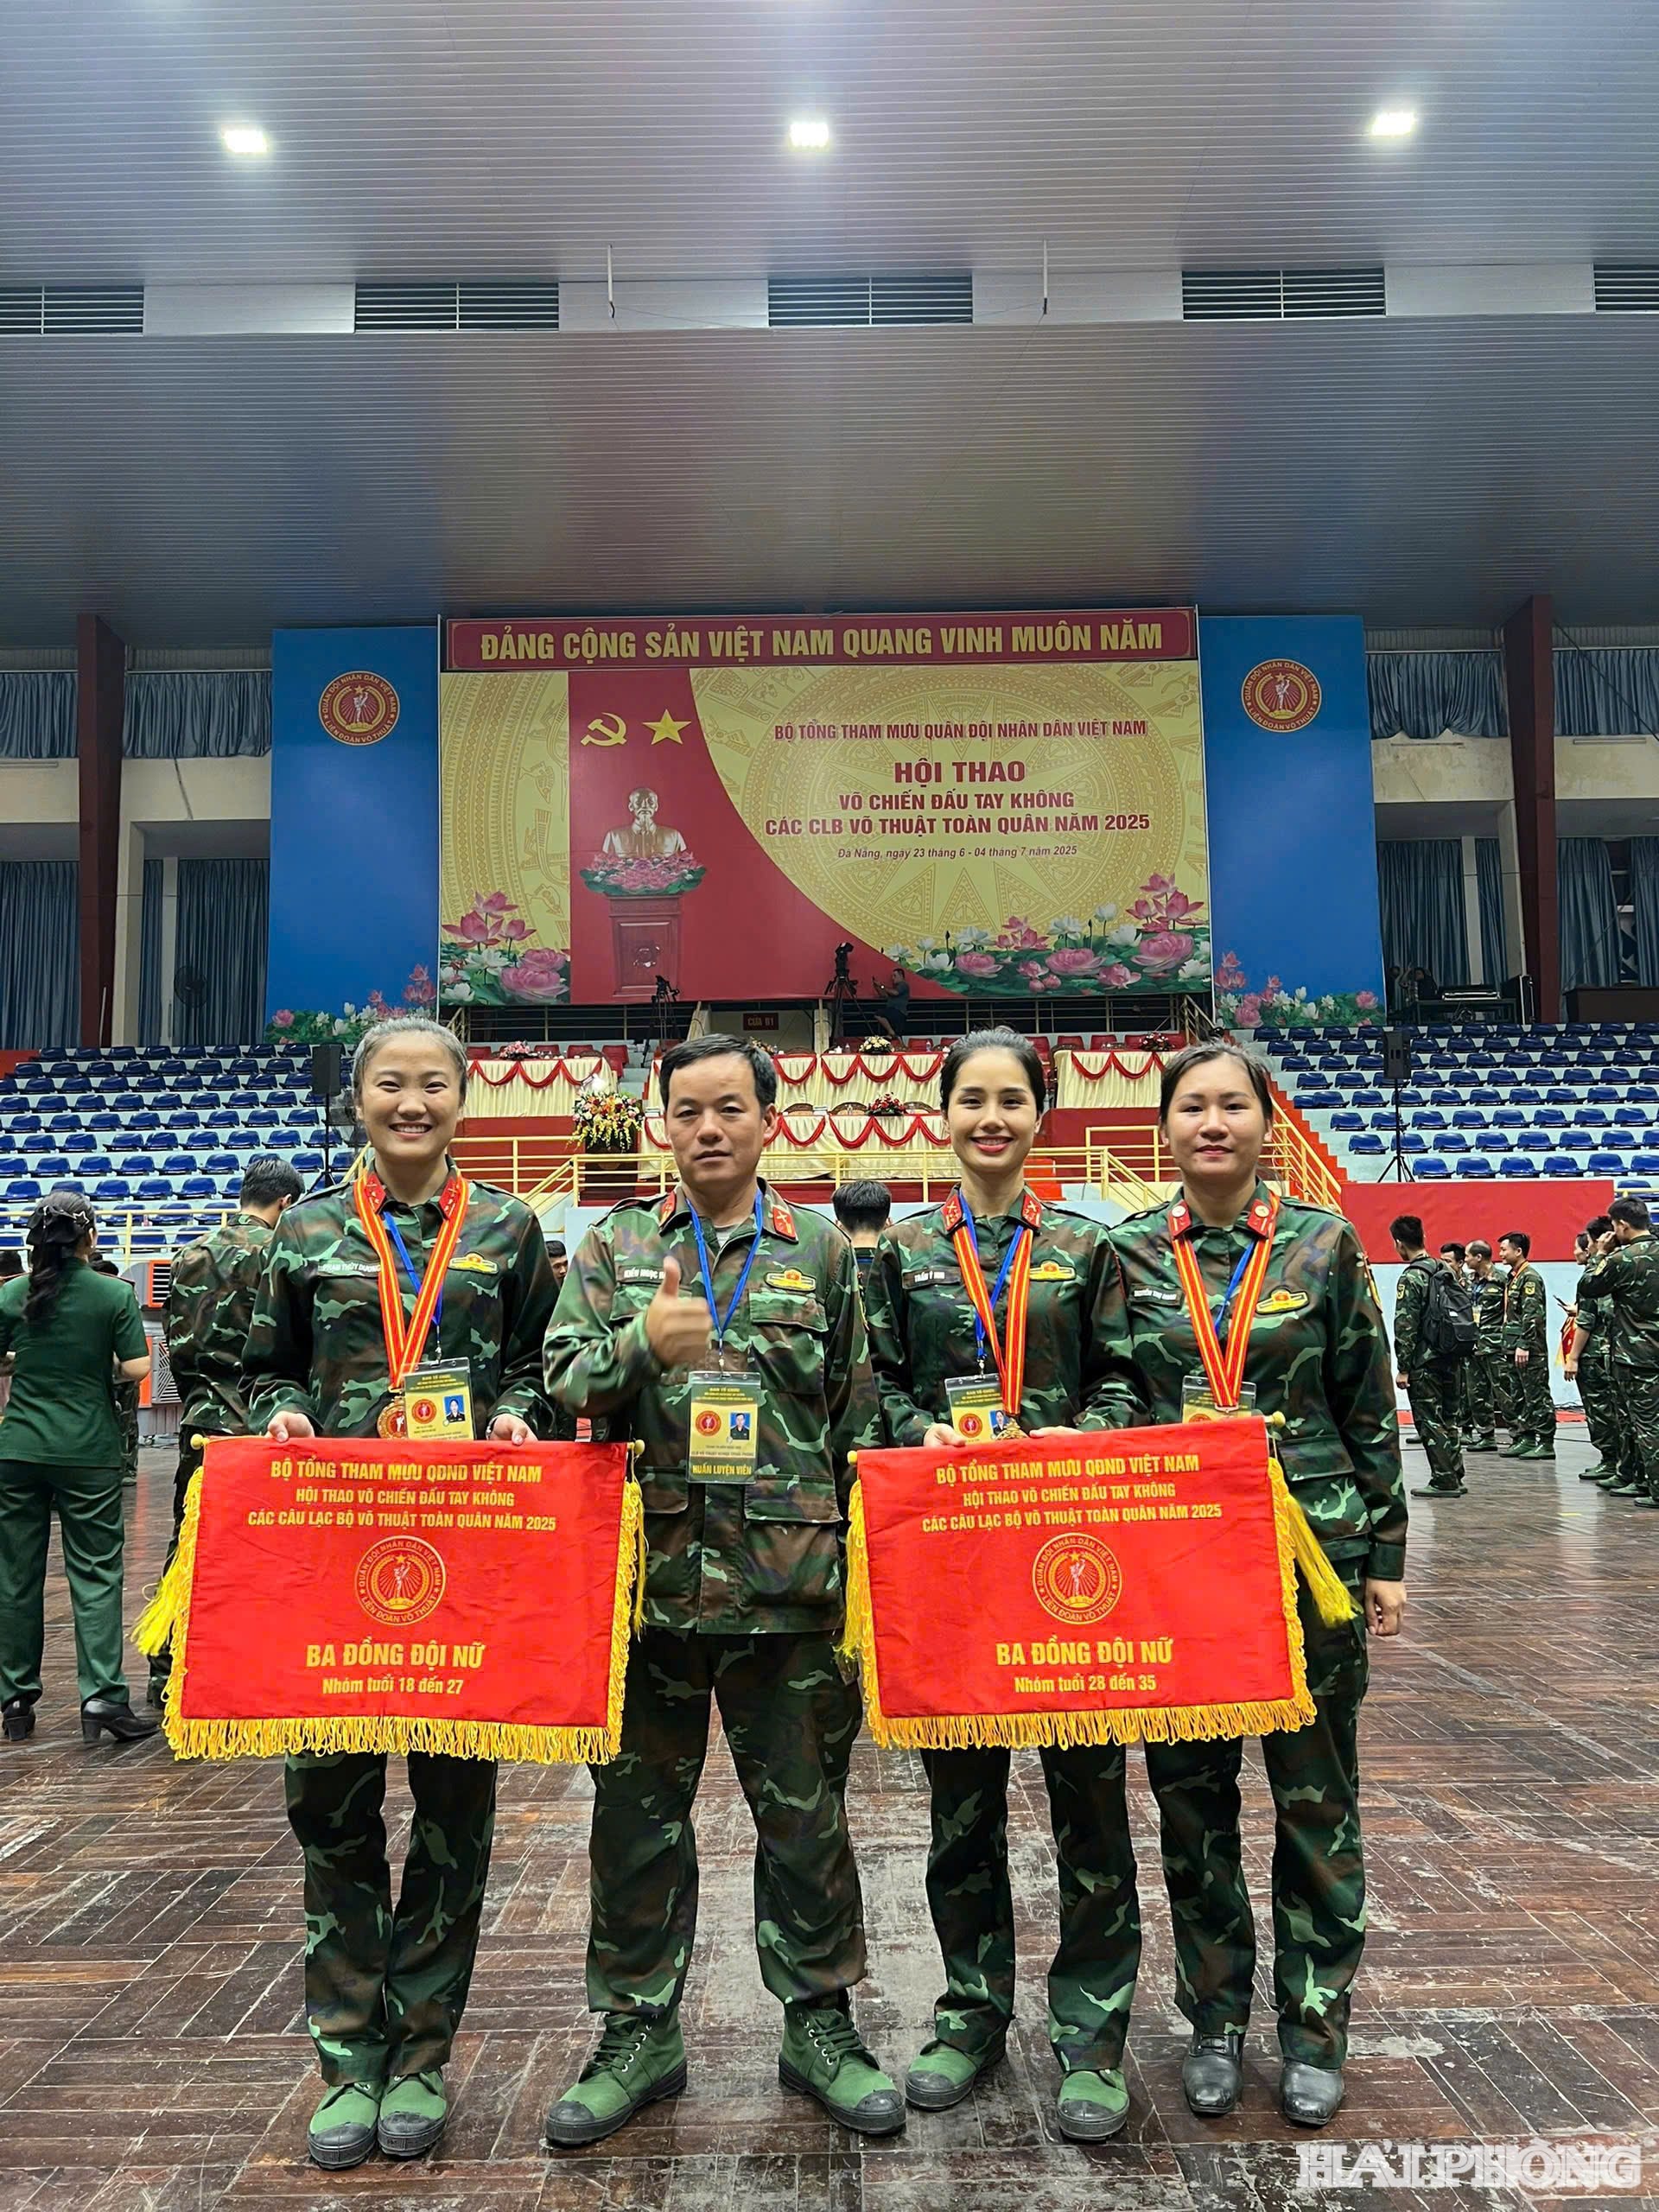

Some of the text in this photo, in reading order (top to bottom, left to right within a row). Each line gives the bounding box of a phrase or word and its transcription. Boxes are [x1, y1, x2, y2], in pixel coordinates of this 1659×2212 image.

[481, 619, 1162, 664] ĐẢNG CỘNG SẢN VIỆT NAM QUANG VINH MUÔN NĂM
[774, 719, 1147, 742] BỘ TỔNG THAM MƯU QUÂN ĐỘI NHÂN DÂN VIỆT NAM
[894, 758, 1026, 789] HỘI THAO
[839, 788, 1074, 810] VÕ CHIẾN ĐẤU TAY KHÔNG
[765, 812, 1149, 837] CÁC CLB VÕ THUẬT TOÀN QUÂN NĂM 2025
[837, 848, 851, 858] Đà
[887, 849, 911, 860] ngày
[913, 849, 925, 857] 23
[928, 849, 957, 859] tháng
[959, 849, 965, 857] 6
[974, 848, 986, 857] 04
[988, 848, 1017, 858] tháng
[1020, 847, 1026, 856] 7
[1029, 848, 1051, 856] năm
[1053, 846, 1077, 855] 2025
[270, 1455, 542, 1484] BỘ TỔNG THAM MƯU QĐND VIỆT NAM
[937, 1453, 1199, 1487] BỘ TỔNG THAM MƯU QĐND VIỆT NAM
[296, 1486, 515, 1507] HỘI THAO VÕ CHIẾN ĐẤU TAY KHÔNG
[963, 1482, 1175, 1510] HỘI THAO VÕ CHIẾN ĐẤU TAY KHÔNG
[248, 1508, 556, 1531] CÁC CÂU LẠC BỘ VÕ THUẬT TOÀN QUÂN NĂM 2025
[922, 1503, 1222, 1532] CÁC CÂU LẠC BỘ VÕ THUẬT TOÀN QUÂN NĂM 2025
[306, 1636, 486, 1671] BA ĐỒNG ĐỘI NỮ
[996, 1635, 1174, 1669] BA ĐỒNG ĐỘI NỮ
[322, 1673, 464, 1694] Nhóm tuổi 18 đến 27
[1014, 1673, 1156, 1693] Nhóm tuổi 28 đến 35
